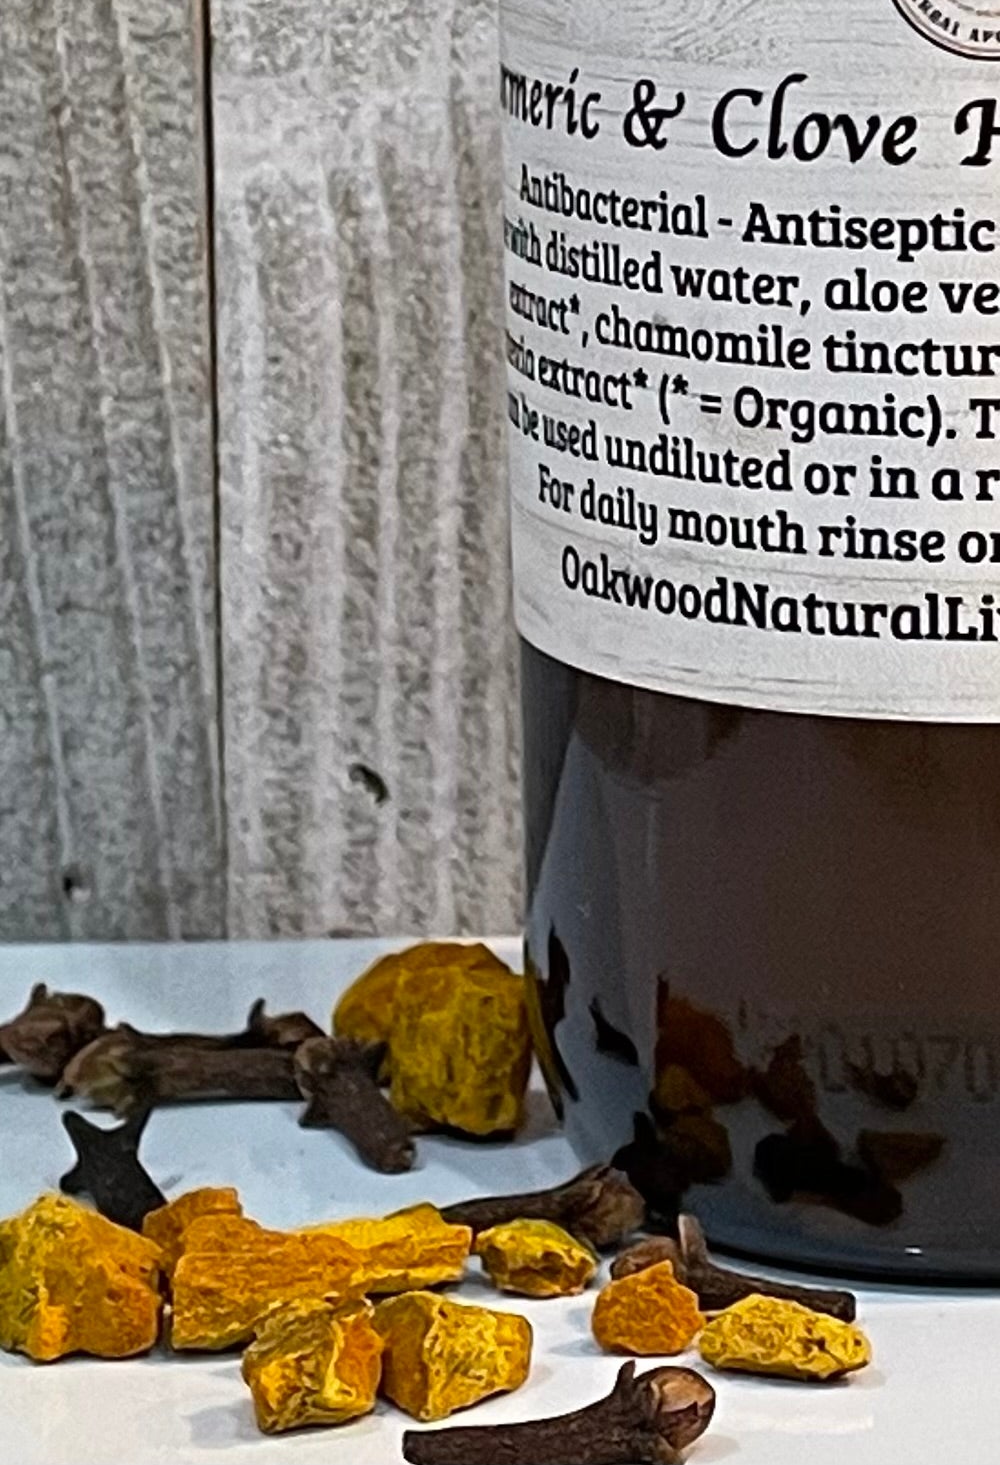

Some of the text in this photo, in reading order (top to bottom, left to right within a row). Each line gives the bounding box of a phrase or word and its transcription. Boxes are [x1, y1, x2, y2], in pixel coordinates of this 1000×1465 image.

[624, 79, 686, 150] &
[712, 74, 917, 166] Clove
[520, 162, 708, 238] Antibacterial
[742, 203, 995, 262] Antiseptic
[546, 230, 662, 294] distilled
[671, 265, 811, 317] water,
[825, 268, 928, 313] aloe
[595, 304, 811, 370] chamomile
[542, 415, 598, 462] used
[605, 433, 793, 491] undiluted
[804, 467, 857, 496] or
[869, 455, 920, 499] in
[932, 470, 963, 501] a
[700, 394, 722, 414] =
[734, 386, 956, 446] Organic).
[538, 463, 574, 512] For
[580, 478, 658, 545] daily
[668, 506, 807, 555] mouth
[819, 516, 945, 563] rinse
